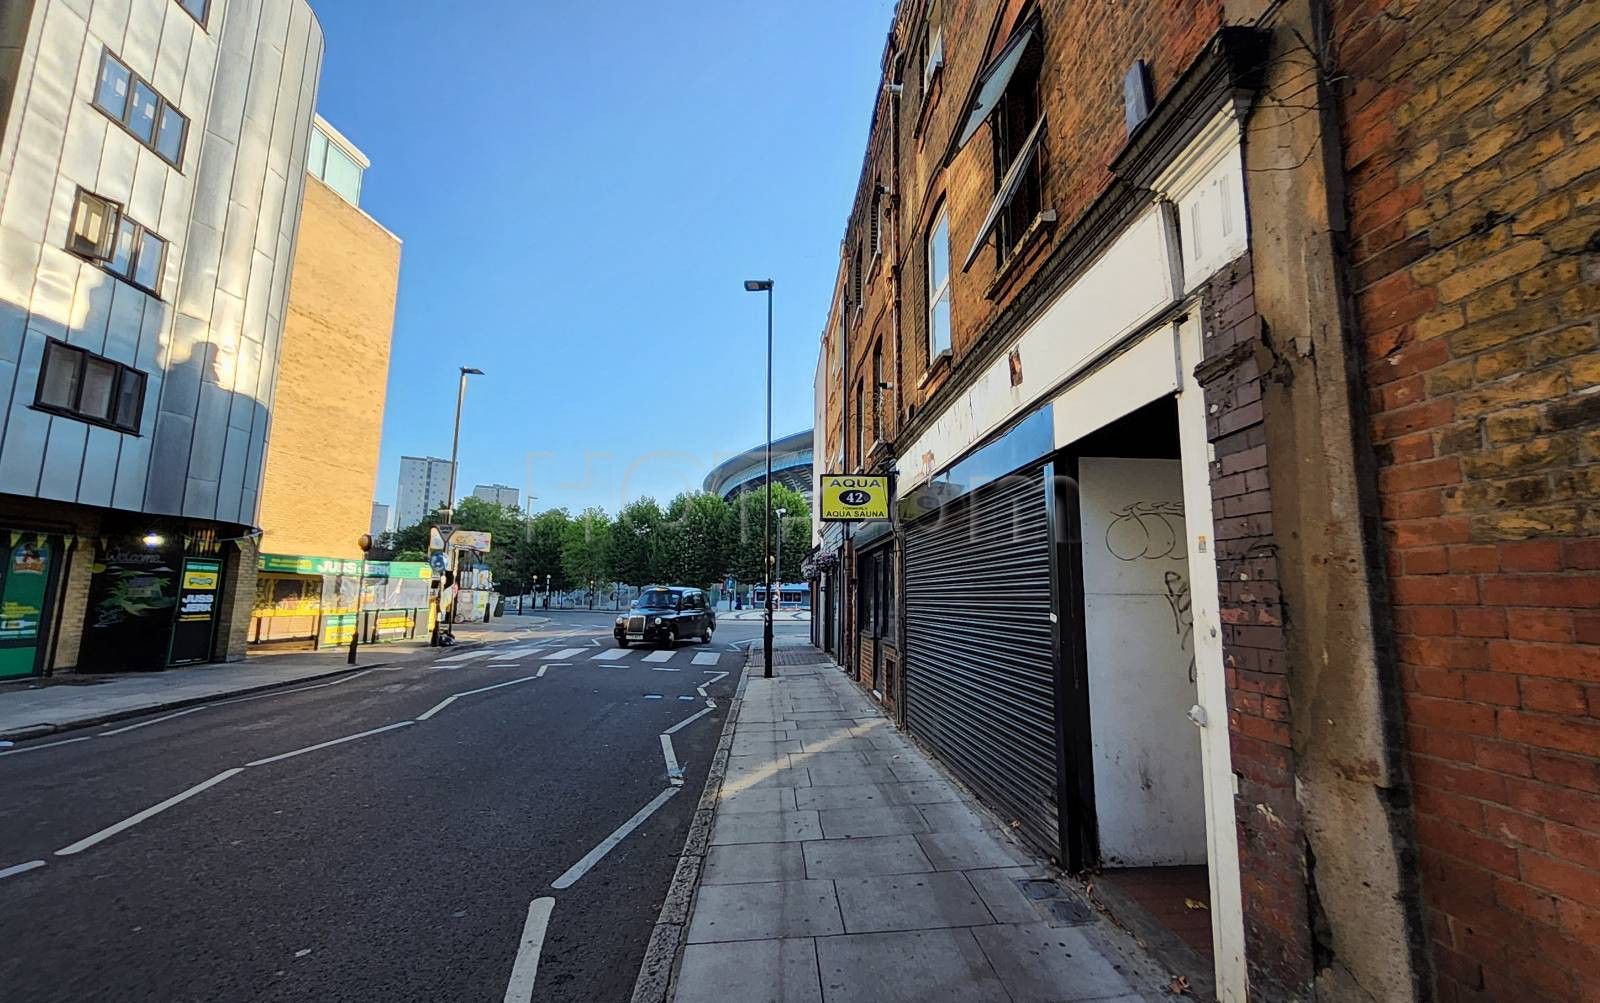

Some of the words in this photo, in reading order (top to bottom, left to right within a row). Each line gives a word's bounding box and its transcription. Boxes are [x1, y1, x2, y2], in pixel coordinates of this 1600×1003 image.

[830, 478, 881, 488] AQUA
[846, 492, 863, 503] 42
[182, 594, 214, 603] JUSS
[181, 604, 212, 612] JERK
